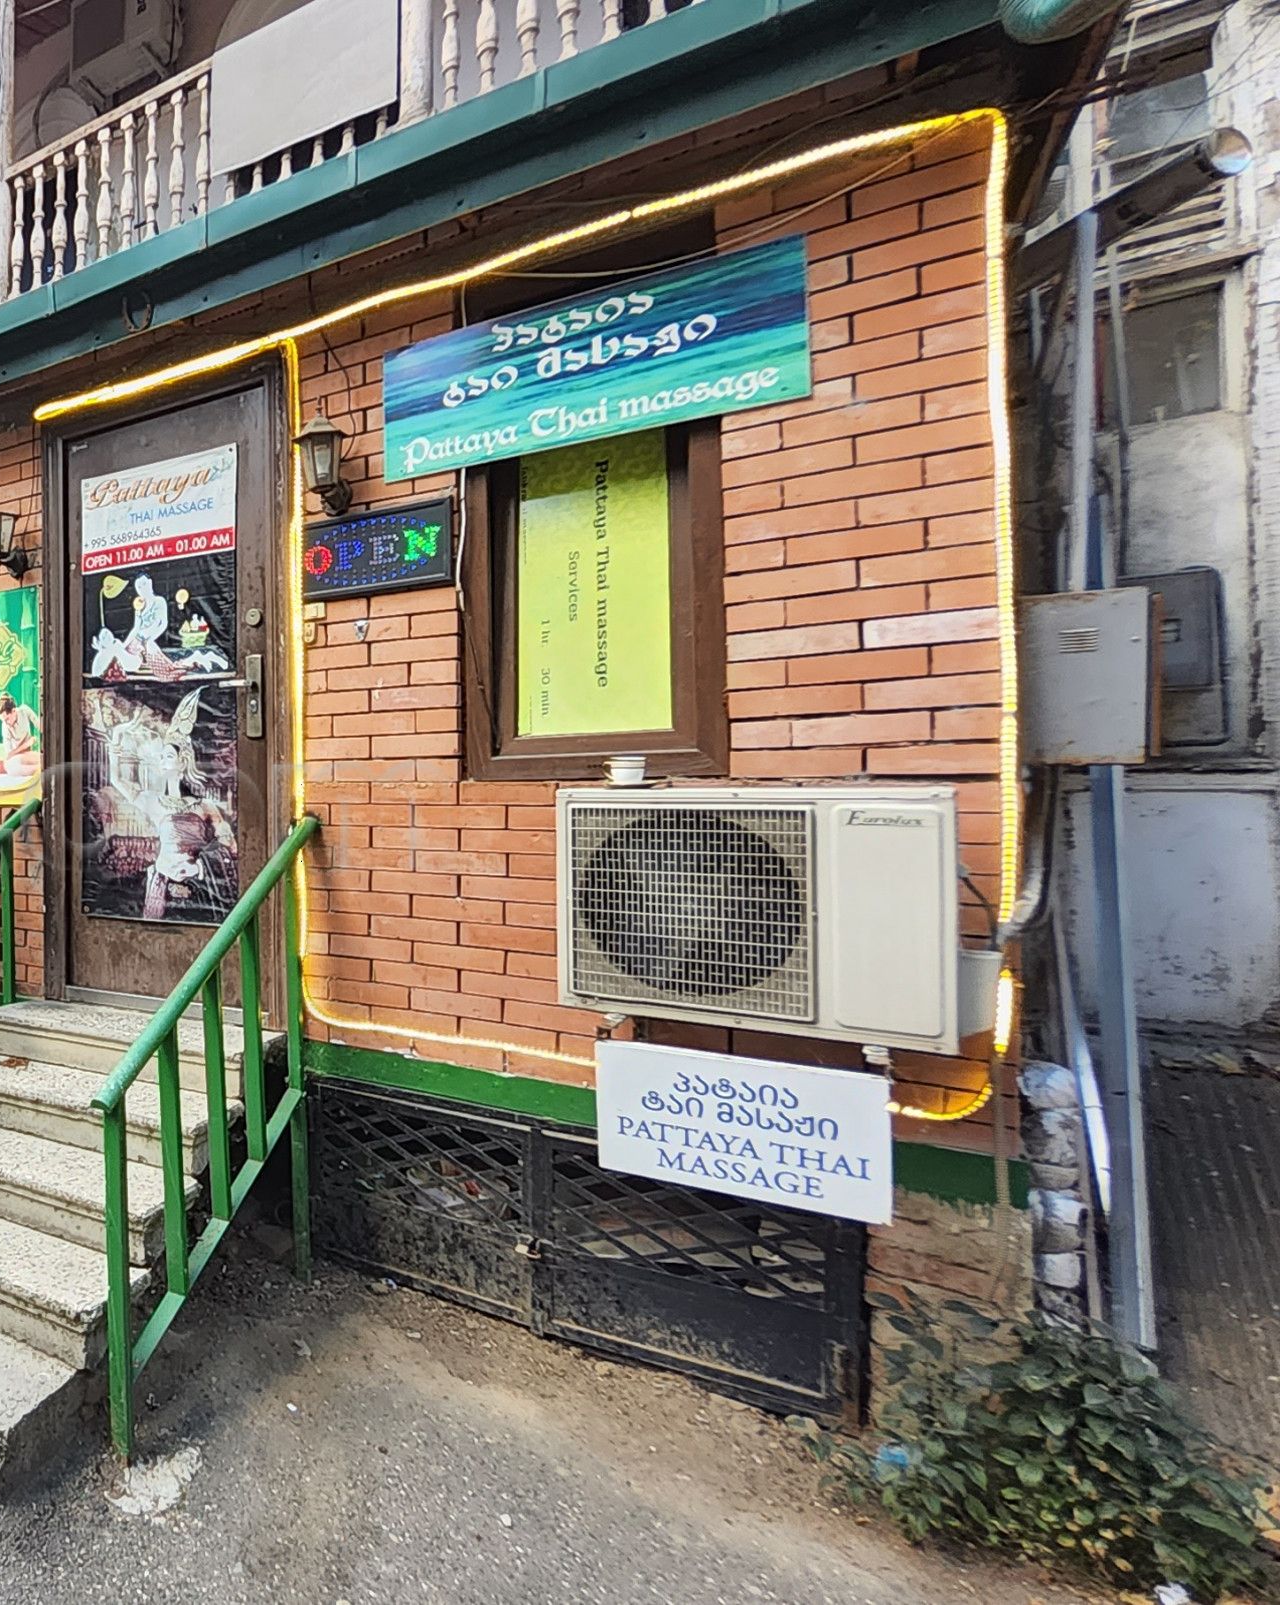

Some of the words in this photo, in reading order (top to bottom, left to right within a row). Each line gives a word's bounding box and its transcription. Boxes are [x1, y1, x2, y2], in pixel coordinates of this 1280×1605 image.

[491, 291, 654, 352] პატაია
[442, 365, 518, 408] ტაი
[536, 313, 717, 378] მასაჟი
[400, 424, 519, 474] Pattaya
[527, 395, 608, 438] Thai
[618, 366, 780, 417] massage
[85, 467, 212, 511] Pattaya
[129, 509, 154, 525] THAI
[158, 497, 214, 518] MASSAGE
[593, 459, 610, 541] Pattaya
[85, 553, 113, 569] OPEN
[116, 546, 144, 563] 11.00
[145, 543, 165, 558] AM
[175, 536, 207, 553] 01.00
[209, 533, 230, 547] AM
[110, 525, 162, 546] 568964365
[304, 525, 442, 575] OPEN
[568, 550, 580, 622] Services
[596, 545, 610, 592] Thai
[594, 598, 608, 687] massage
[541, 667, 550, 685] 30
[641, 1090, 704, 1119] ტაი
[716, 1101, 839, 1141] მასაჟი
[673, 1071, 799, 1110] პატაია
[616, 1115, 761, 1161] PATTAYA
[769, 1141, 872, 1181] THAI
[656, 1147, 825, 1199] MASSAGE
